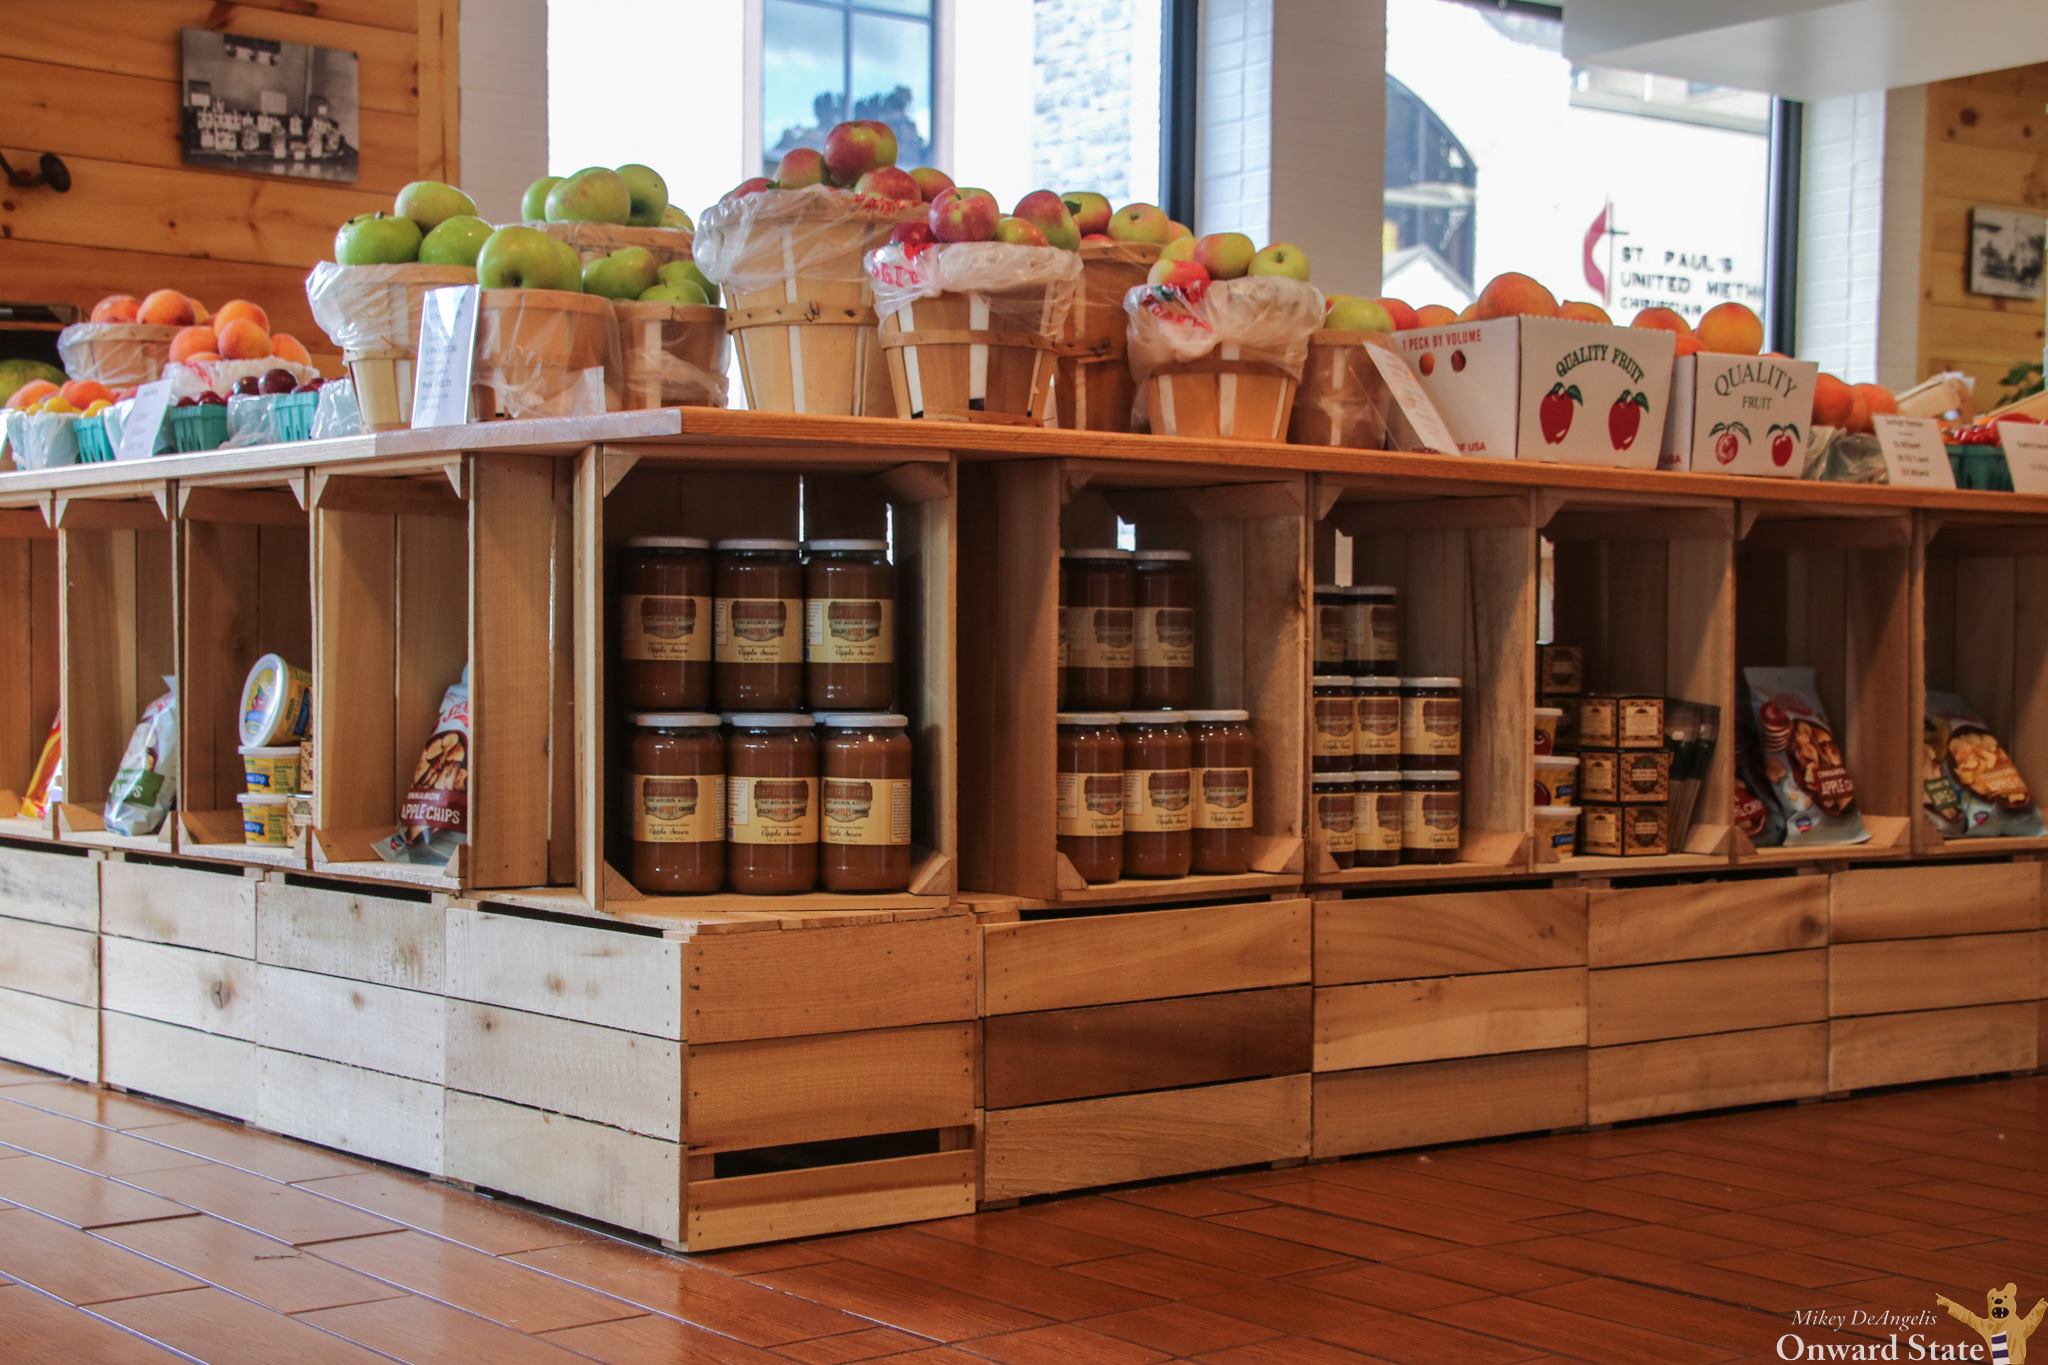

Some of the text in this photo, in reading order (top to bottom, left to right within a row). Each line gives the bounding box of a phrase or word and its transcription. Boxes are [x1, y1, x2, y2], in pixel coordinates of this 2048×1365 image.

[1664, 251, 1733, 273] PAUL'S
[1620, 271, 1691, 293] UNITED
[1402, 329, 1483, 351] 1 PECK BY VOLUME
[1556, 344, 1645, 385] QUALITY FRUIT
[1715, 362, 1798, 398] QUALITY
[1742, 396, 1773, 410] FRUIT
[1468, 442, 1486, 452] USA
[1821, 779, 1845, 796] APPLE
[401, 803, 460, 824] APPLE CHIPS
[761, 828, 781, 838] Apple
